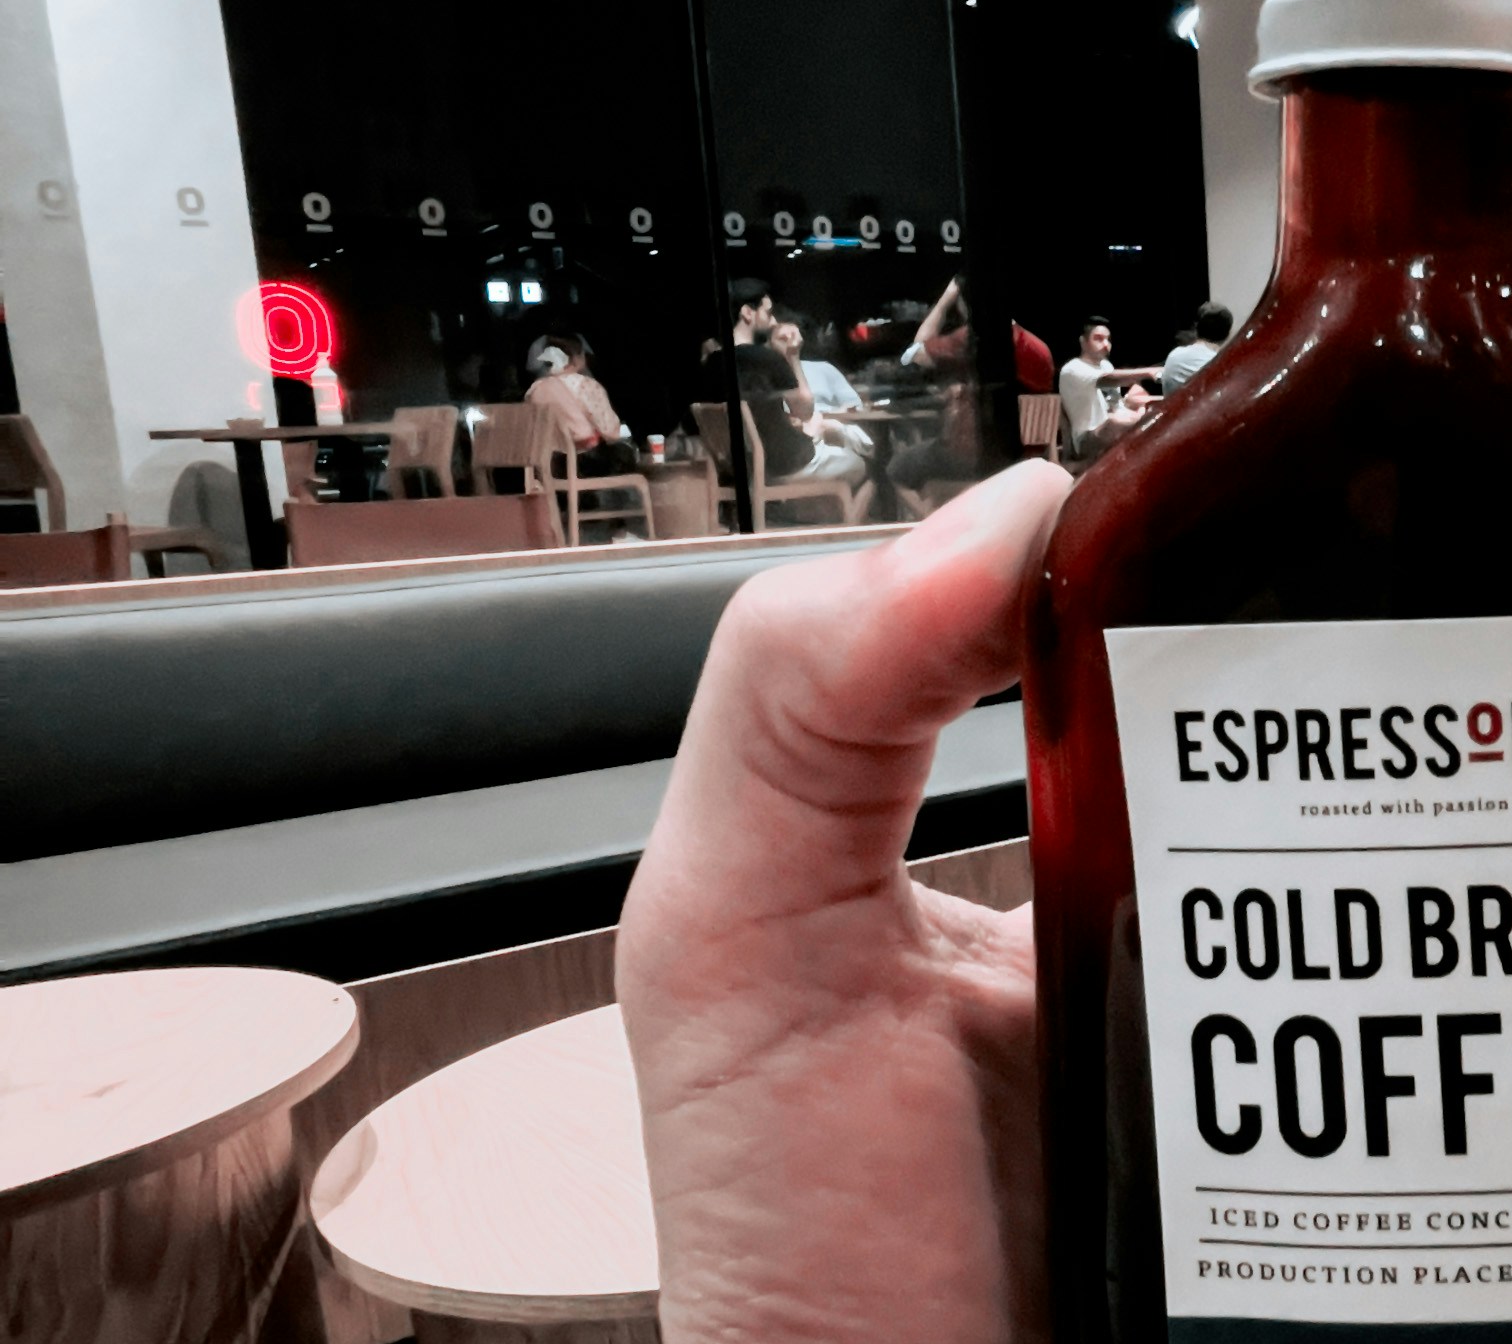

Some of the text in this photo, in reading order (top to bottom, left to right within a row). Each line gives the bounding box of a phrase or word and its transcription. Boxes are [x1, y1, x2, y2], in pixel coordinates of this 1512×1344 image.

[1300, 797, 1509, 817] roasted with passion
[1181, 887, 1384, 981] COLD
[1210, 1207, 1280, 1229] ICED
[1293, 1212, 1412, 1231] COFFEE
[1198, 1260, 1398, 1285] PRODUCTION
